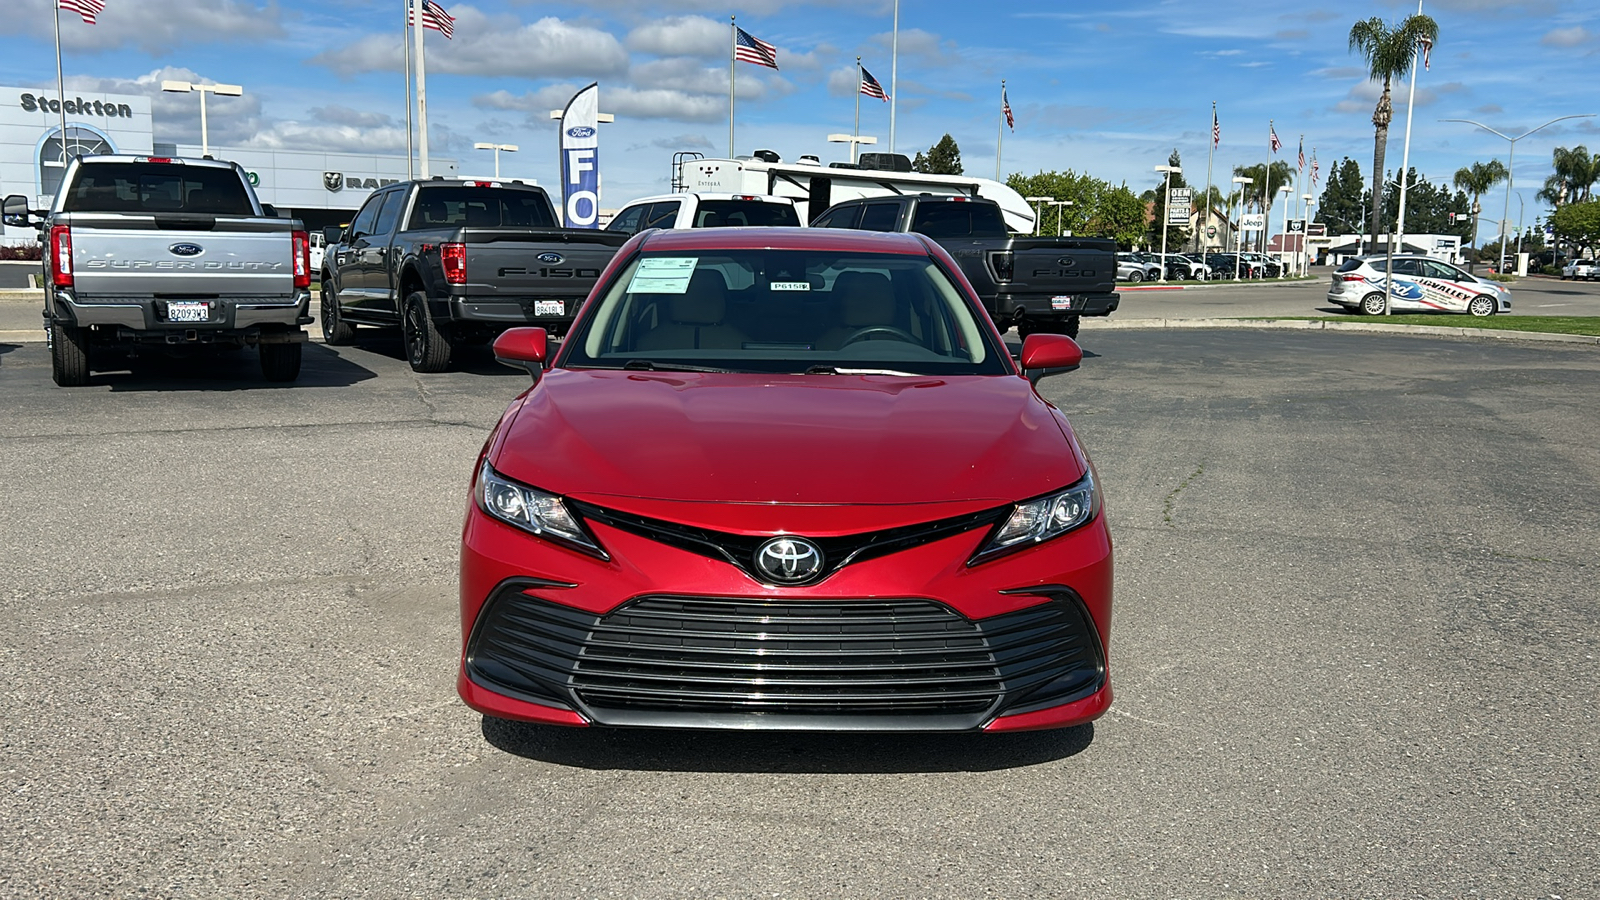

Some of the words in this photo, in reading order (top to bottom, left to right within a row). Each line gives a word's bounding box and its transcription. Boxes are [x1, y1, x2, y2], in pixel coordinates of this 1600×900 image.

[20, 93, 132, 118] Stockton
[571, 127, 592, 138] Ford
[1171, 189, 1191, 197] OEM
[1243, 219, 1263, 228] Jeep
[86, 260, 196, 269] SUPER
[204, 260, 282, 270] DUTY
[498, 268, 600, 278] F-150
[1032, 269, 1096, 277] F-150
